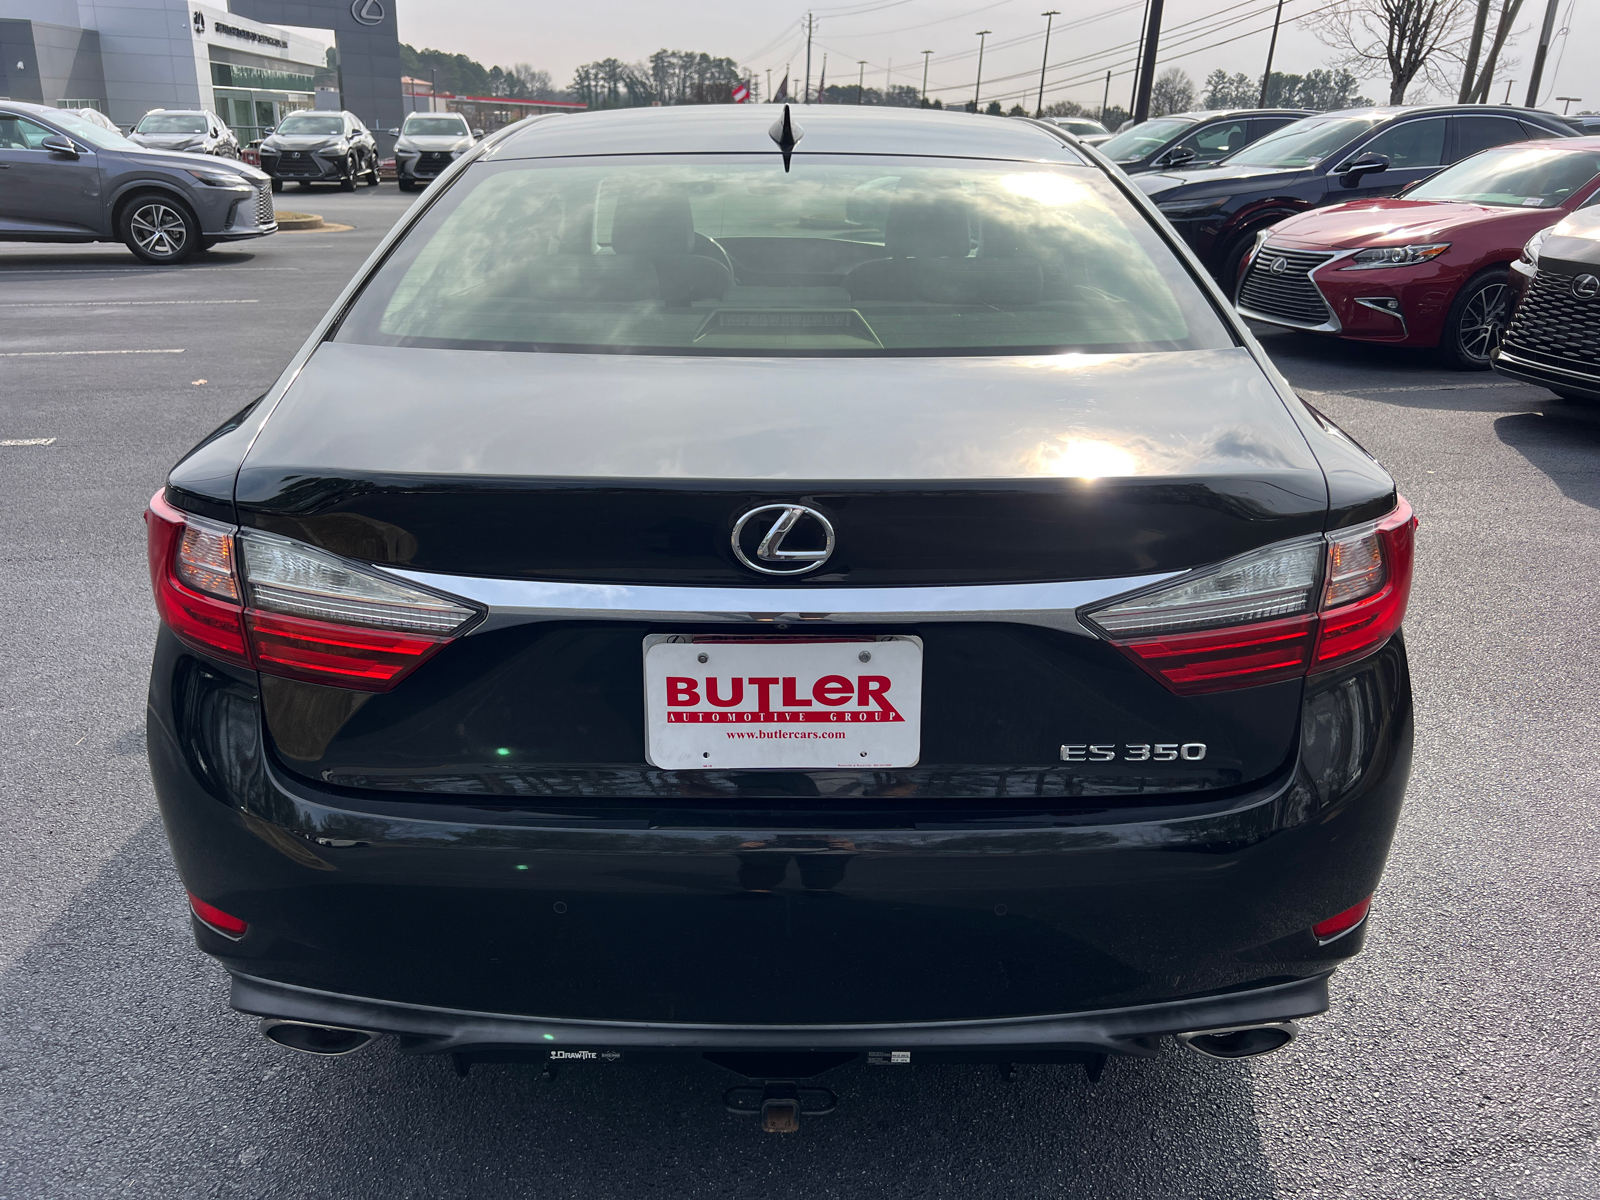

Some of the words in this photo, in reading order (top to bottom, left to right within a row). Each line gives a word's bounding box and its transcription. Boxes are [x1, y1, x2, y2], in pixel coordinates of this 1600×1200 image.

[669, 712, 806, 722] AUTOMOTIVE
[829, 711, 896, 722] GROUP
[726, 729, 846, 740] www.butlercars.com
[1060, 744, 1116, 761] ES
[1124, 742, 1207, 761] 350
